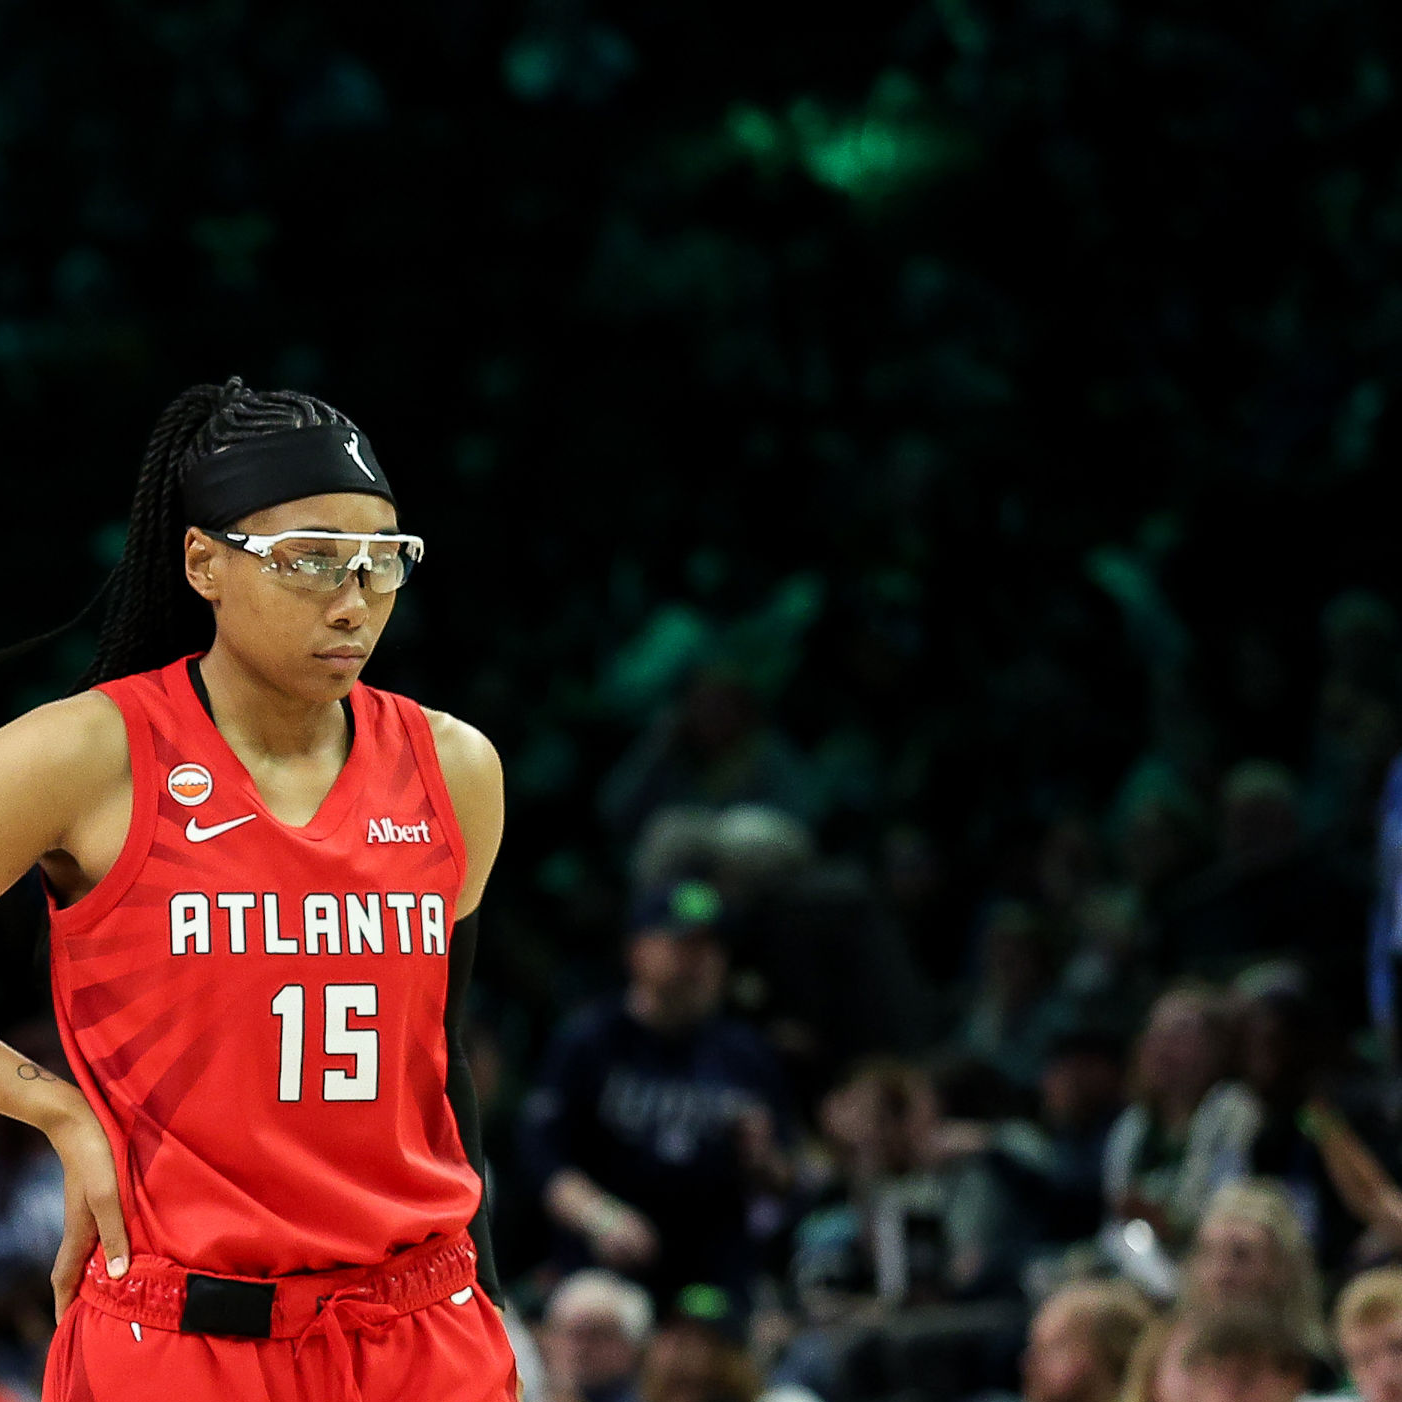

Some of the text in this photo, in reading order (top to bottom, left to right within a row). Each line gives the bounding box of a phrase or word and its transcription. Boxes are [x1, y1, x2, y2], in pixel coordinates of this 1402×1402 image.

[366, 816, 432, 845] Albert
[169, 892, 446, 956] ATLANTA
[271, 984, 379, 1102] 15
